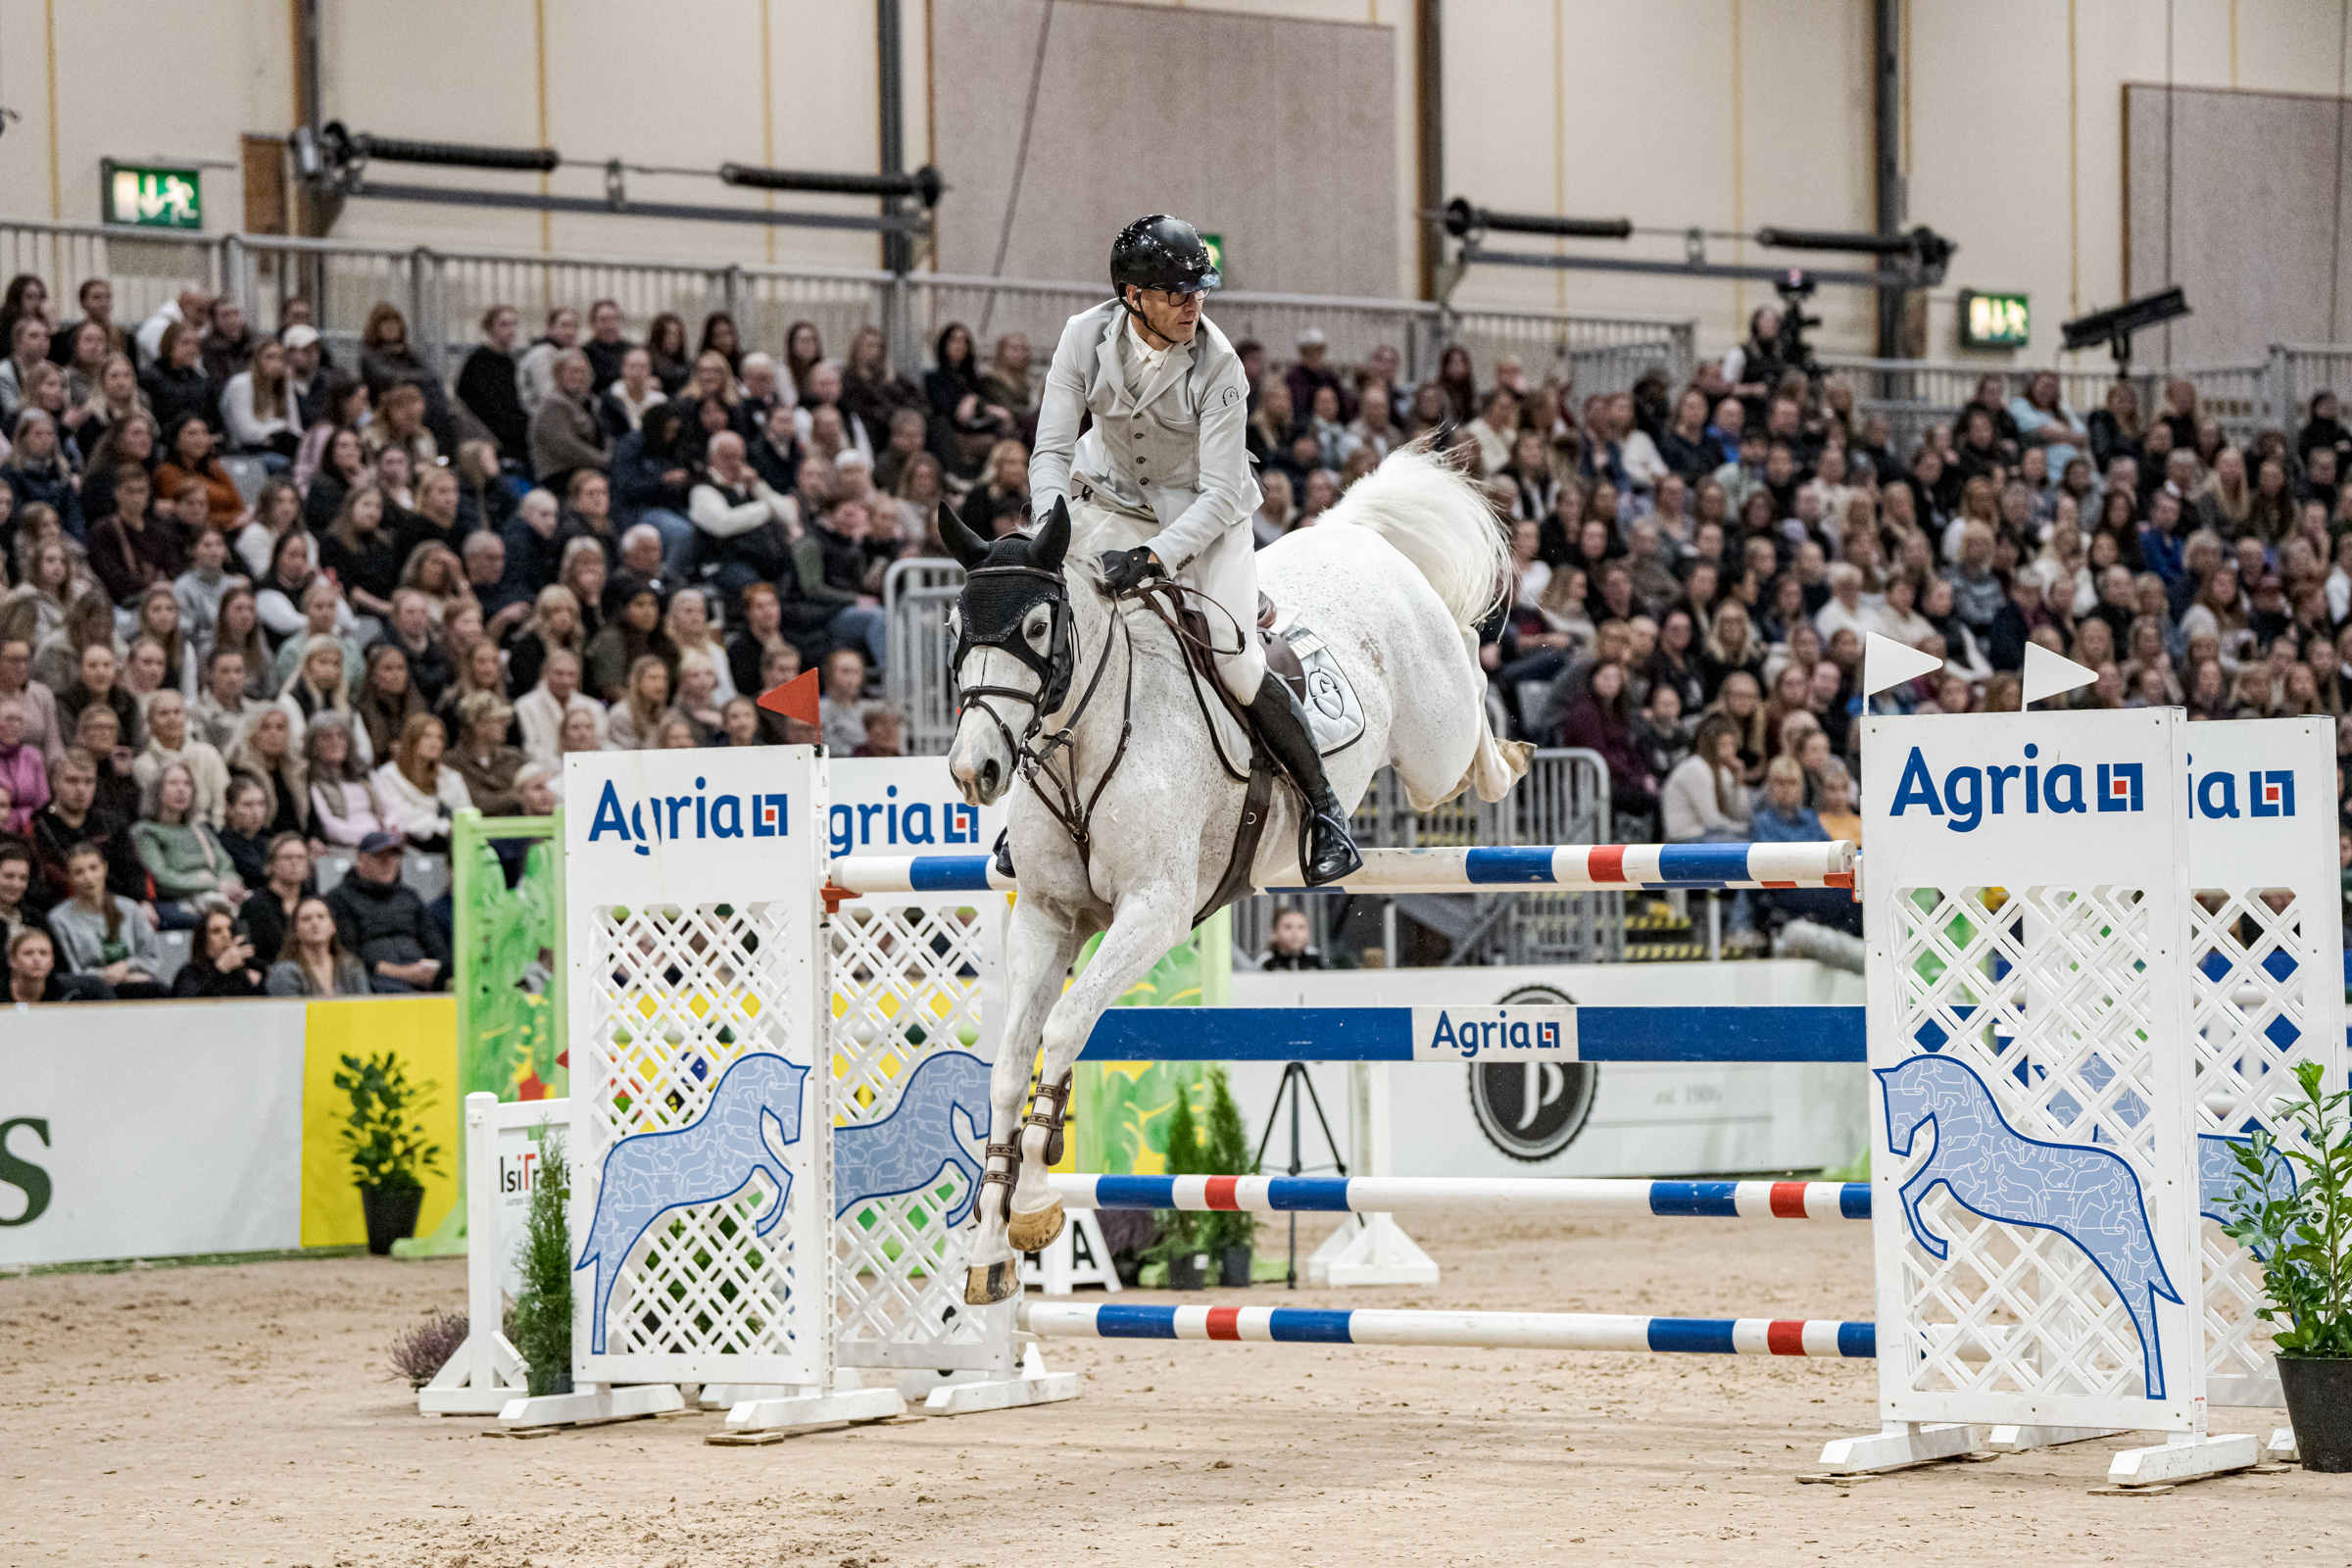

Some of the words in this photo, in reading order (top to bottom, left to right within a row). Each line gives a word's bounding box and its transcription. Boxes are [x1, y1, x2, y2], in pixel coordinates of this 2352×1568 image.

[1889, 743, 2086, 832] Agria
[830, 785, 935, 859] gria
[1431, 1010, 1532, 1057] Agria
[1073, 1220, 1097, 1269] A
